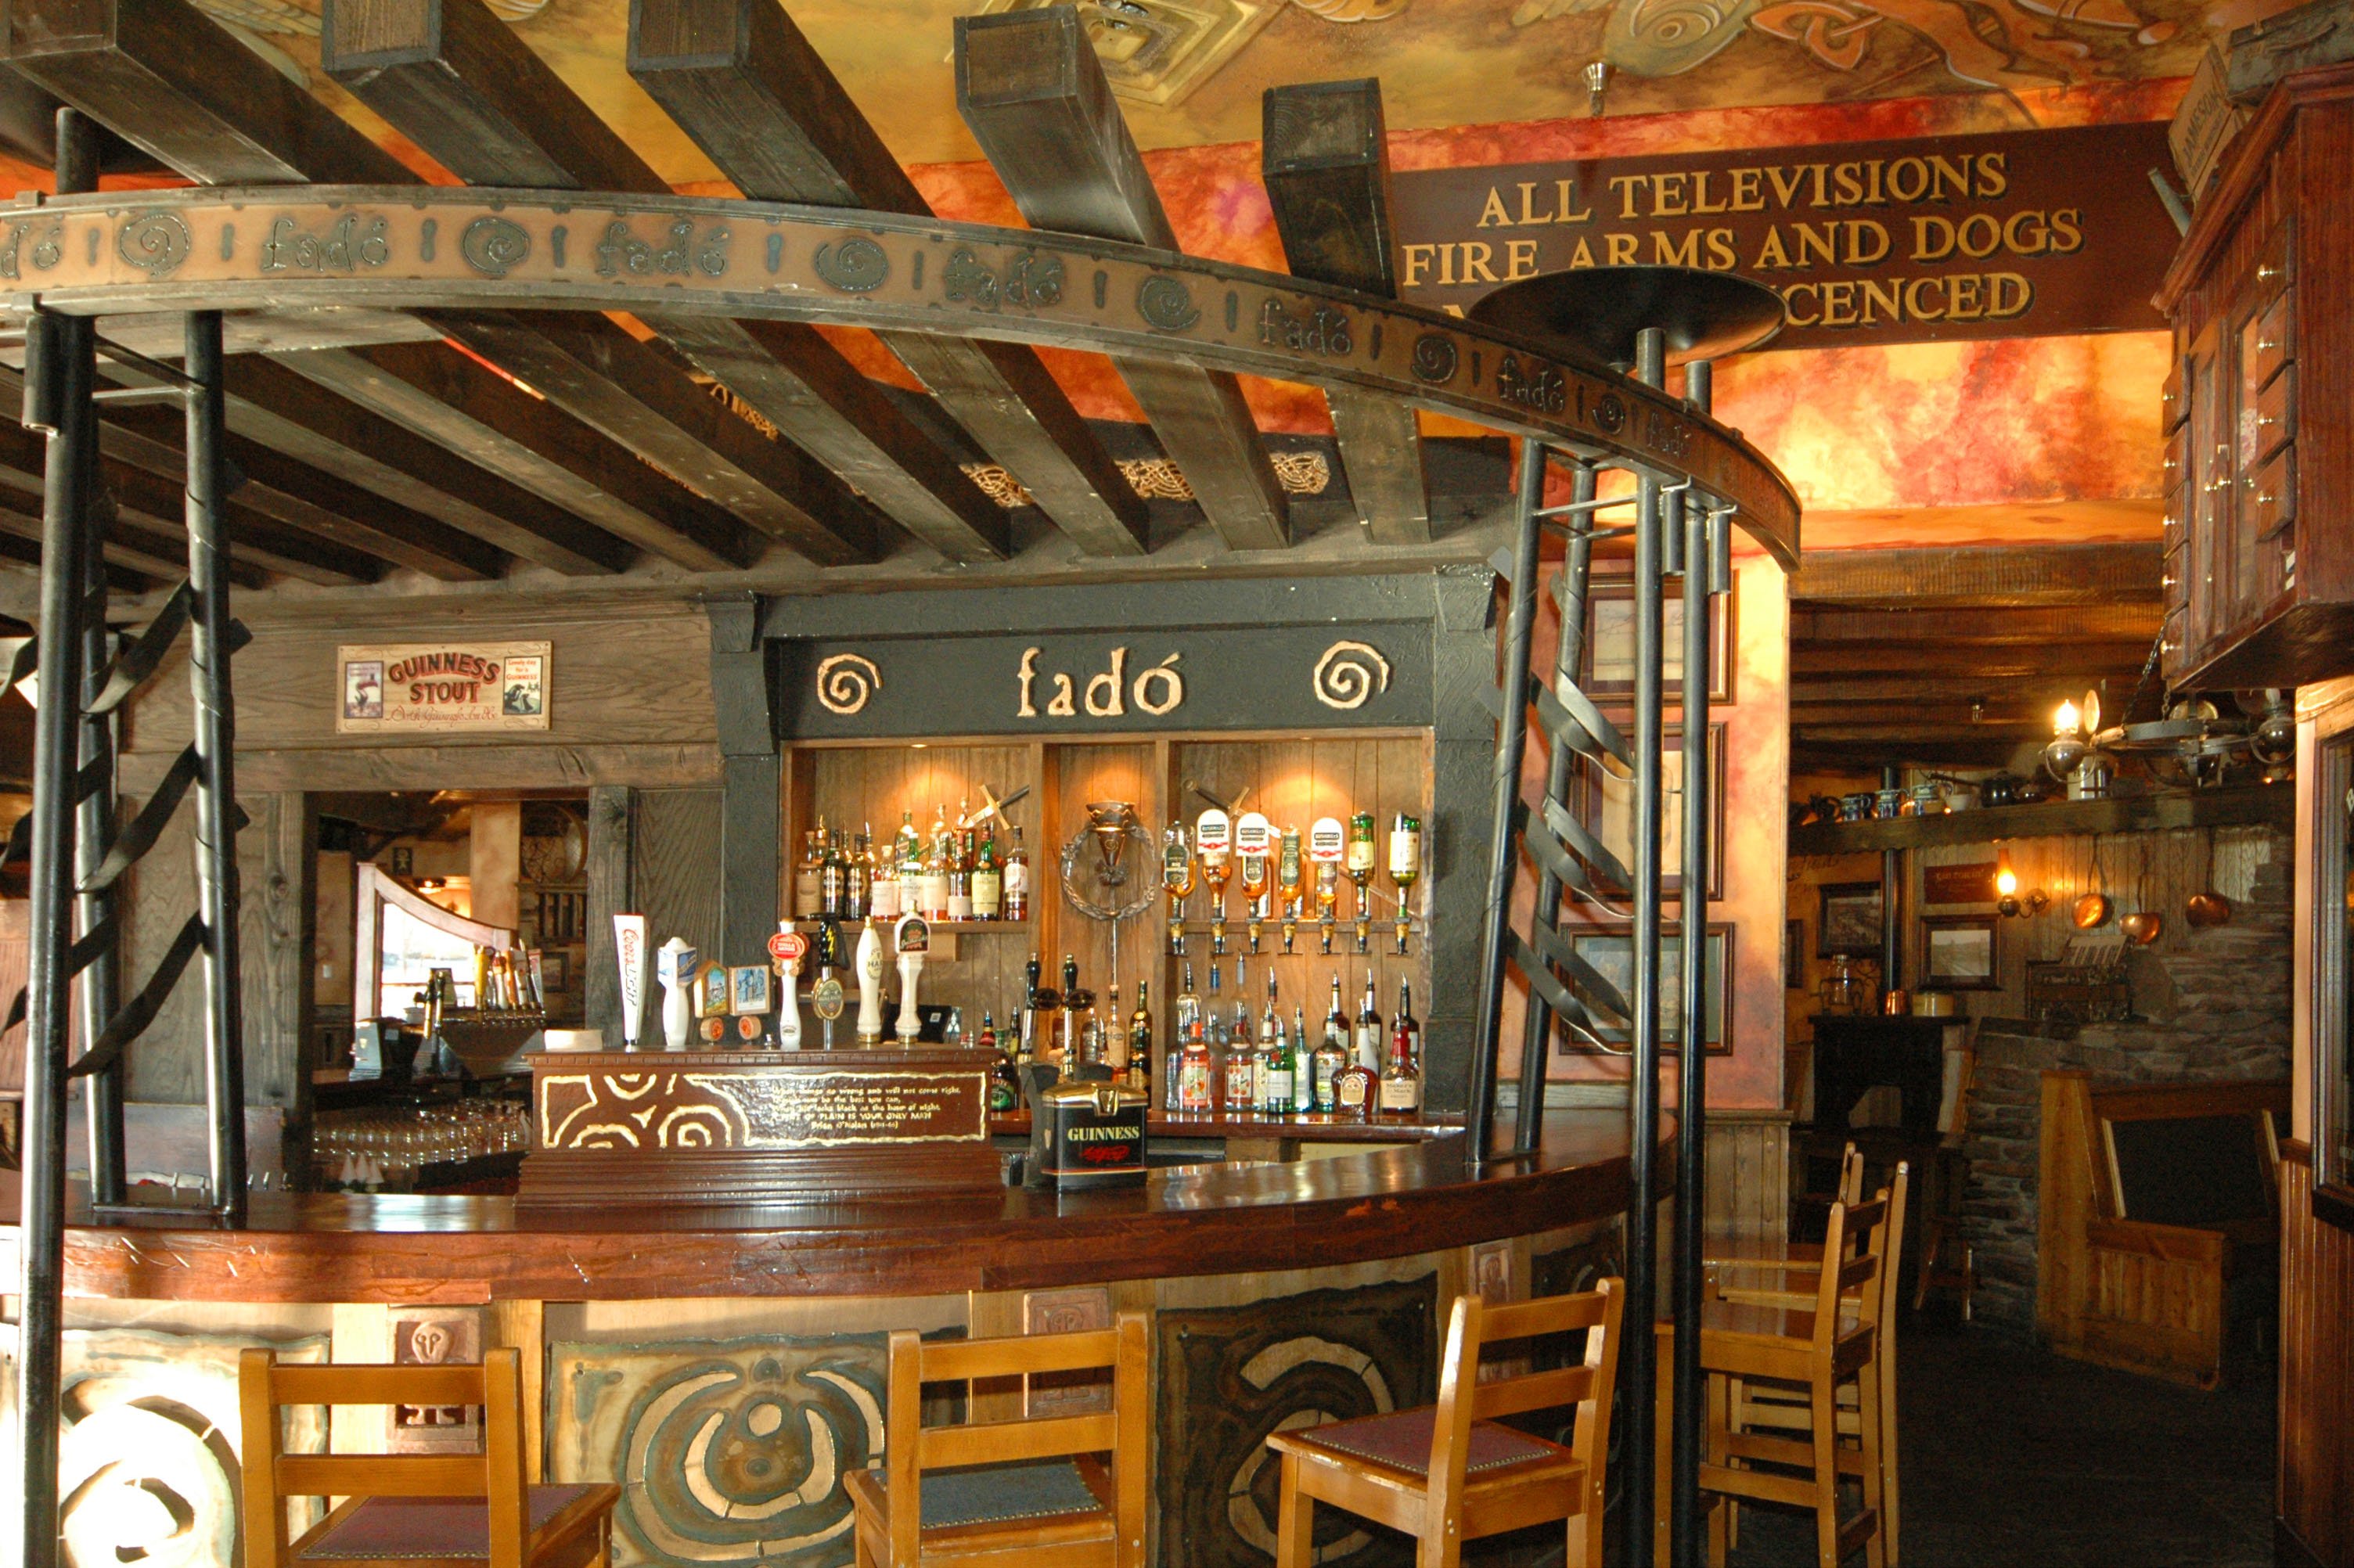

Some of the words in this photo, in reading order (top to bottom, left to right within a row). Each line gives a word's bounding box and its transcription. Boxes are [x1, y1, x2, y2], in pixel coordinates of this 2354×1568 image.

[1477, 181, 1590, 228] ALL
[1609, 153, 2007, 220] TELEVISIONS
[2, 225, 59, 280] dó
[261, 216, 388, 273] fadó
[595, 221, 729, 277] fadó
[1402, 239, 1539, 287] FIRE
[1569, 228, 1737, 271] ARMS
[1753, 221, 1891, 271] AND
[1911, 209, 2085, 262] DOGS
[1781, 272, 2031, 326] CENCED
[389, 652, 501, 685] GUINNESS
[410, 681, 481, 704] STOUT
[1017, 646, 1183, 716] fadó
[819, 1112, 845, 1120] PLAIN
[1067, 1126, 1140, 1142] GUINNESS
